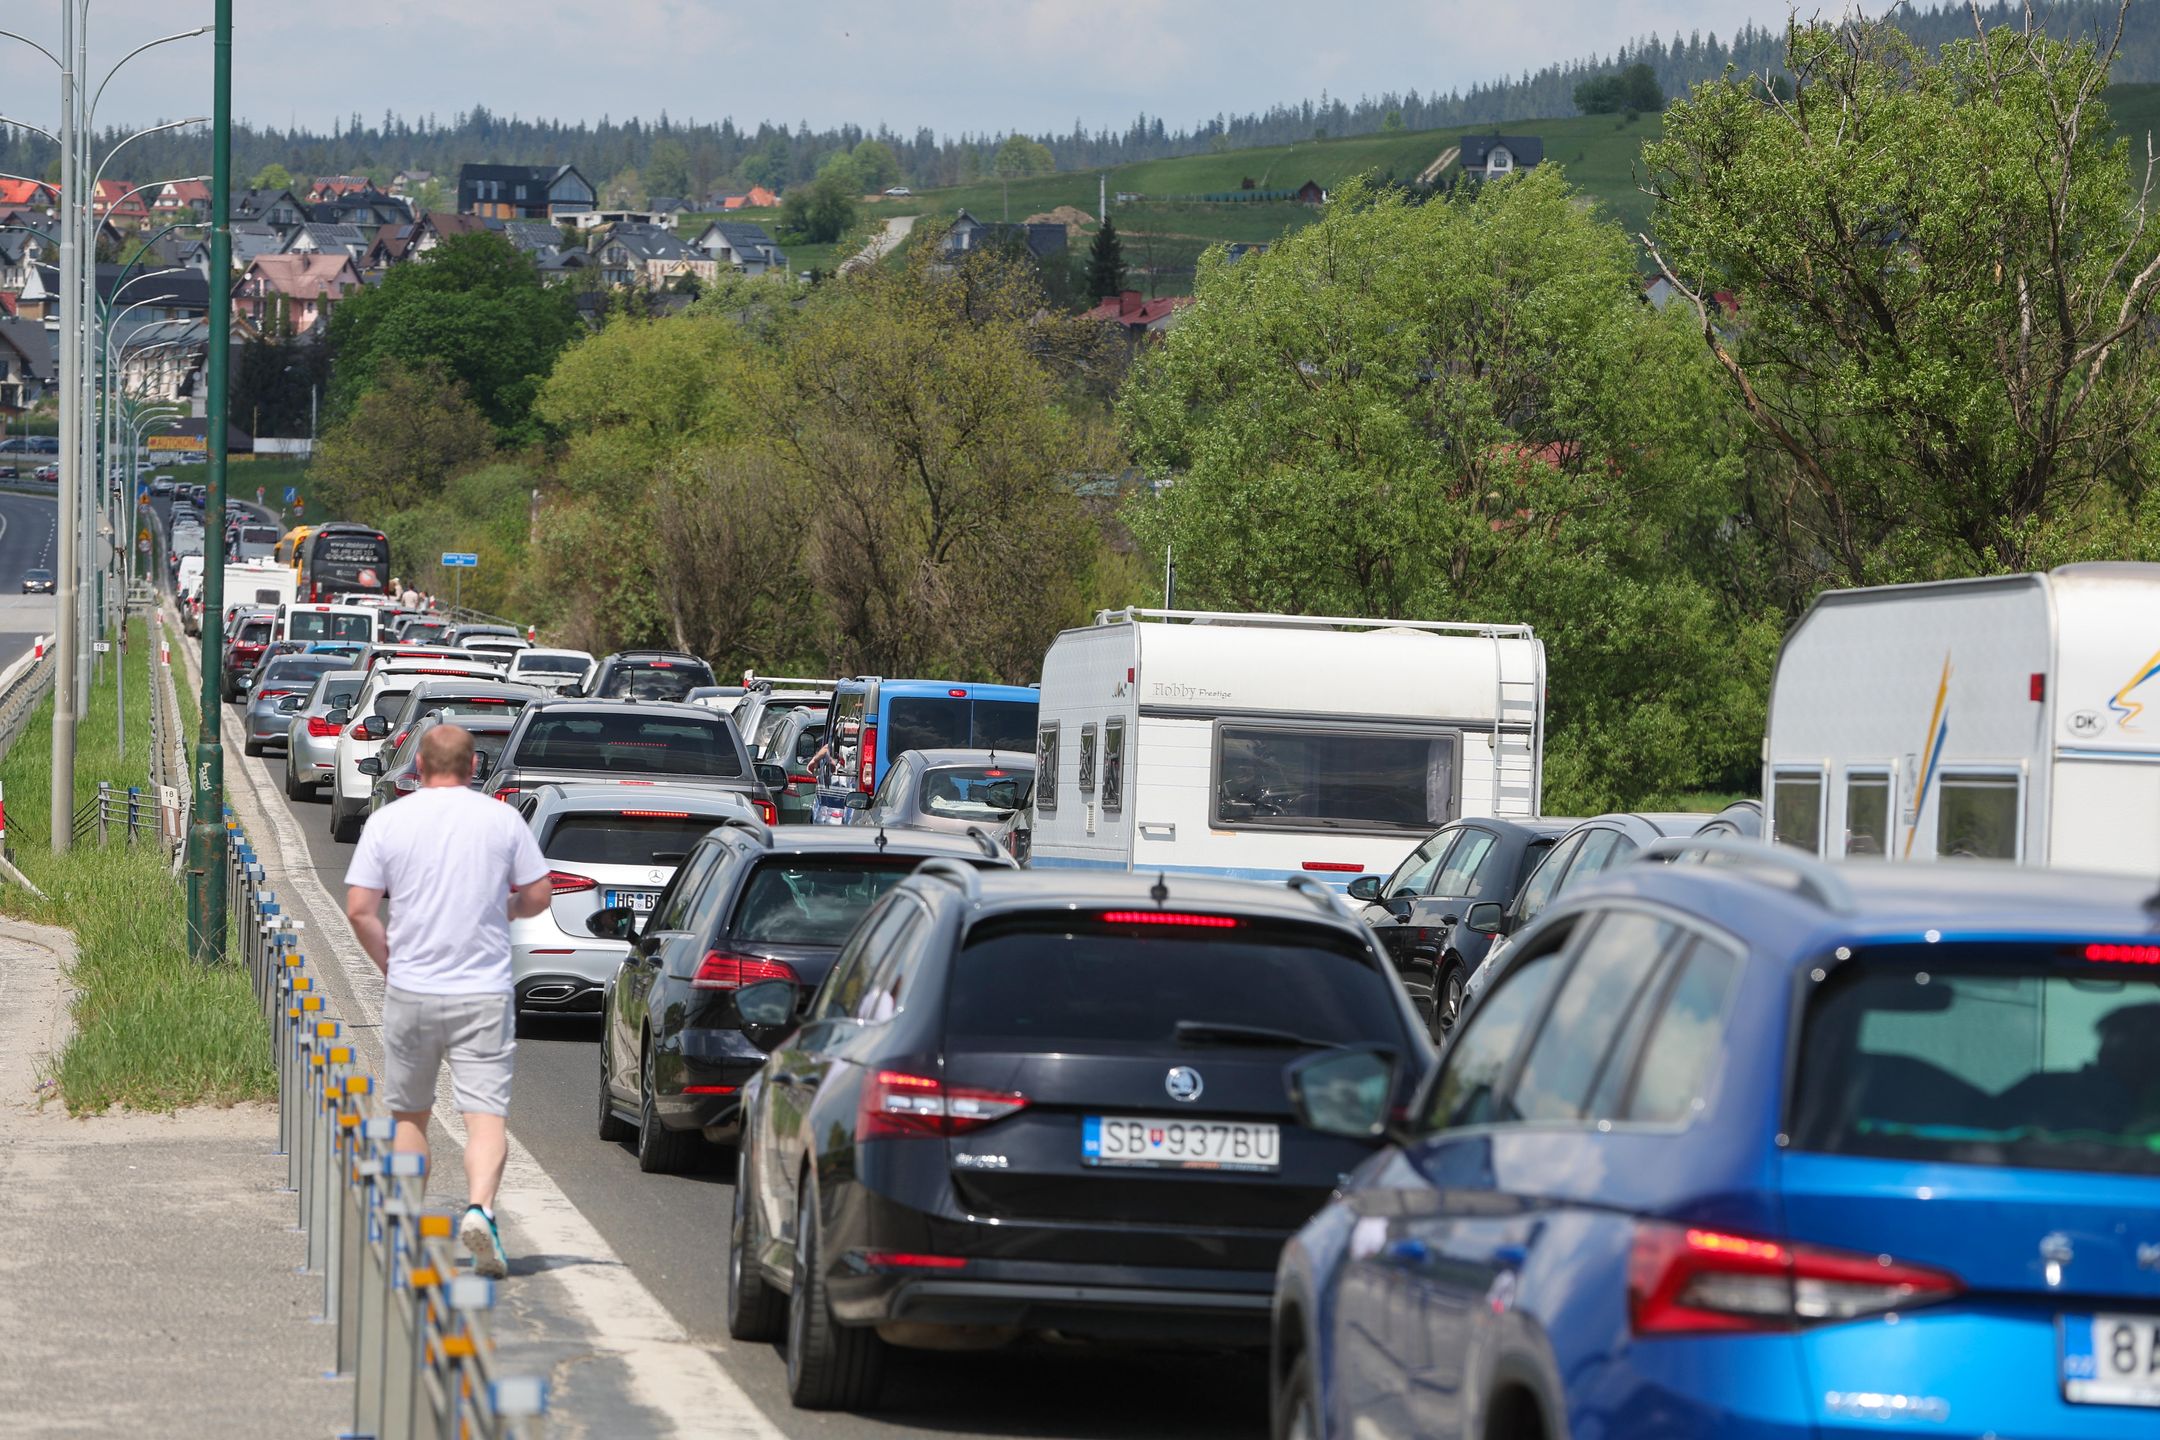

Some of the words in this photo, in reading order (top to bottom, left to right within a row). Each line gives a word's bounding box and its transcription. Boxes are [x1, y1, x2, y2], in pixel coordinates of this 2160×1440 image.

[1152, 682, 1197, 699] Hobby
[1199, 688, 1232, 699] Prestige
[2076, 715, 2097, 729] DK
[616, 893, 635, 909] HG
[1106, 1121, 1146, 1154] SB
[1167, 1124, 1274, 1159] 937BU
